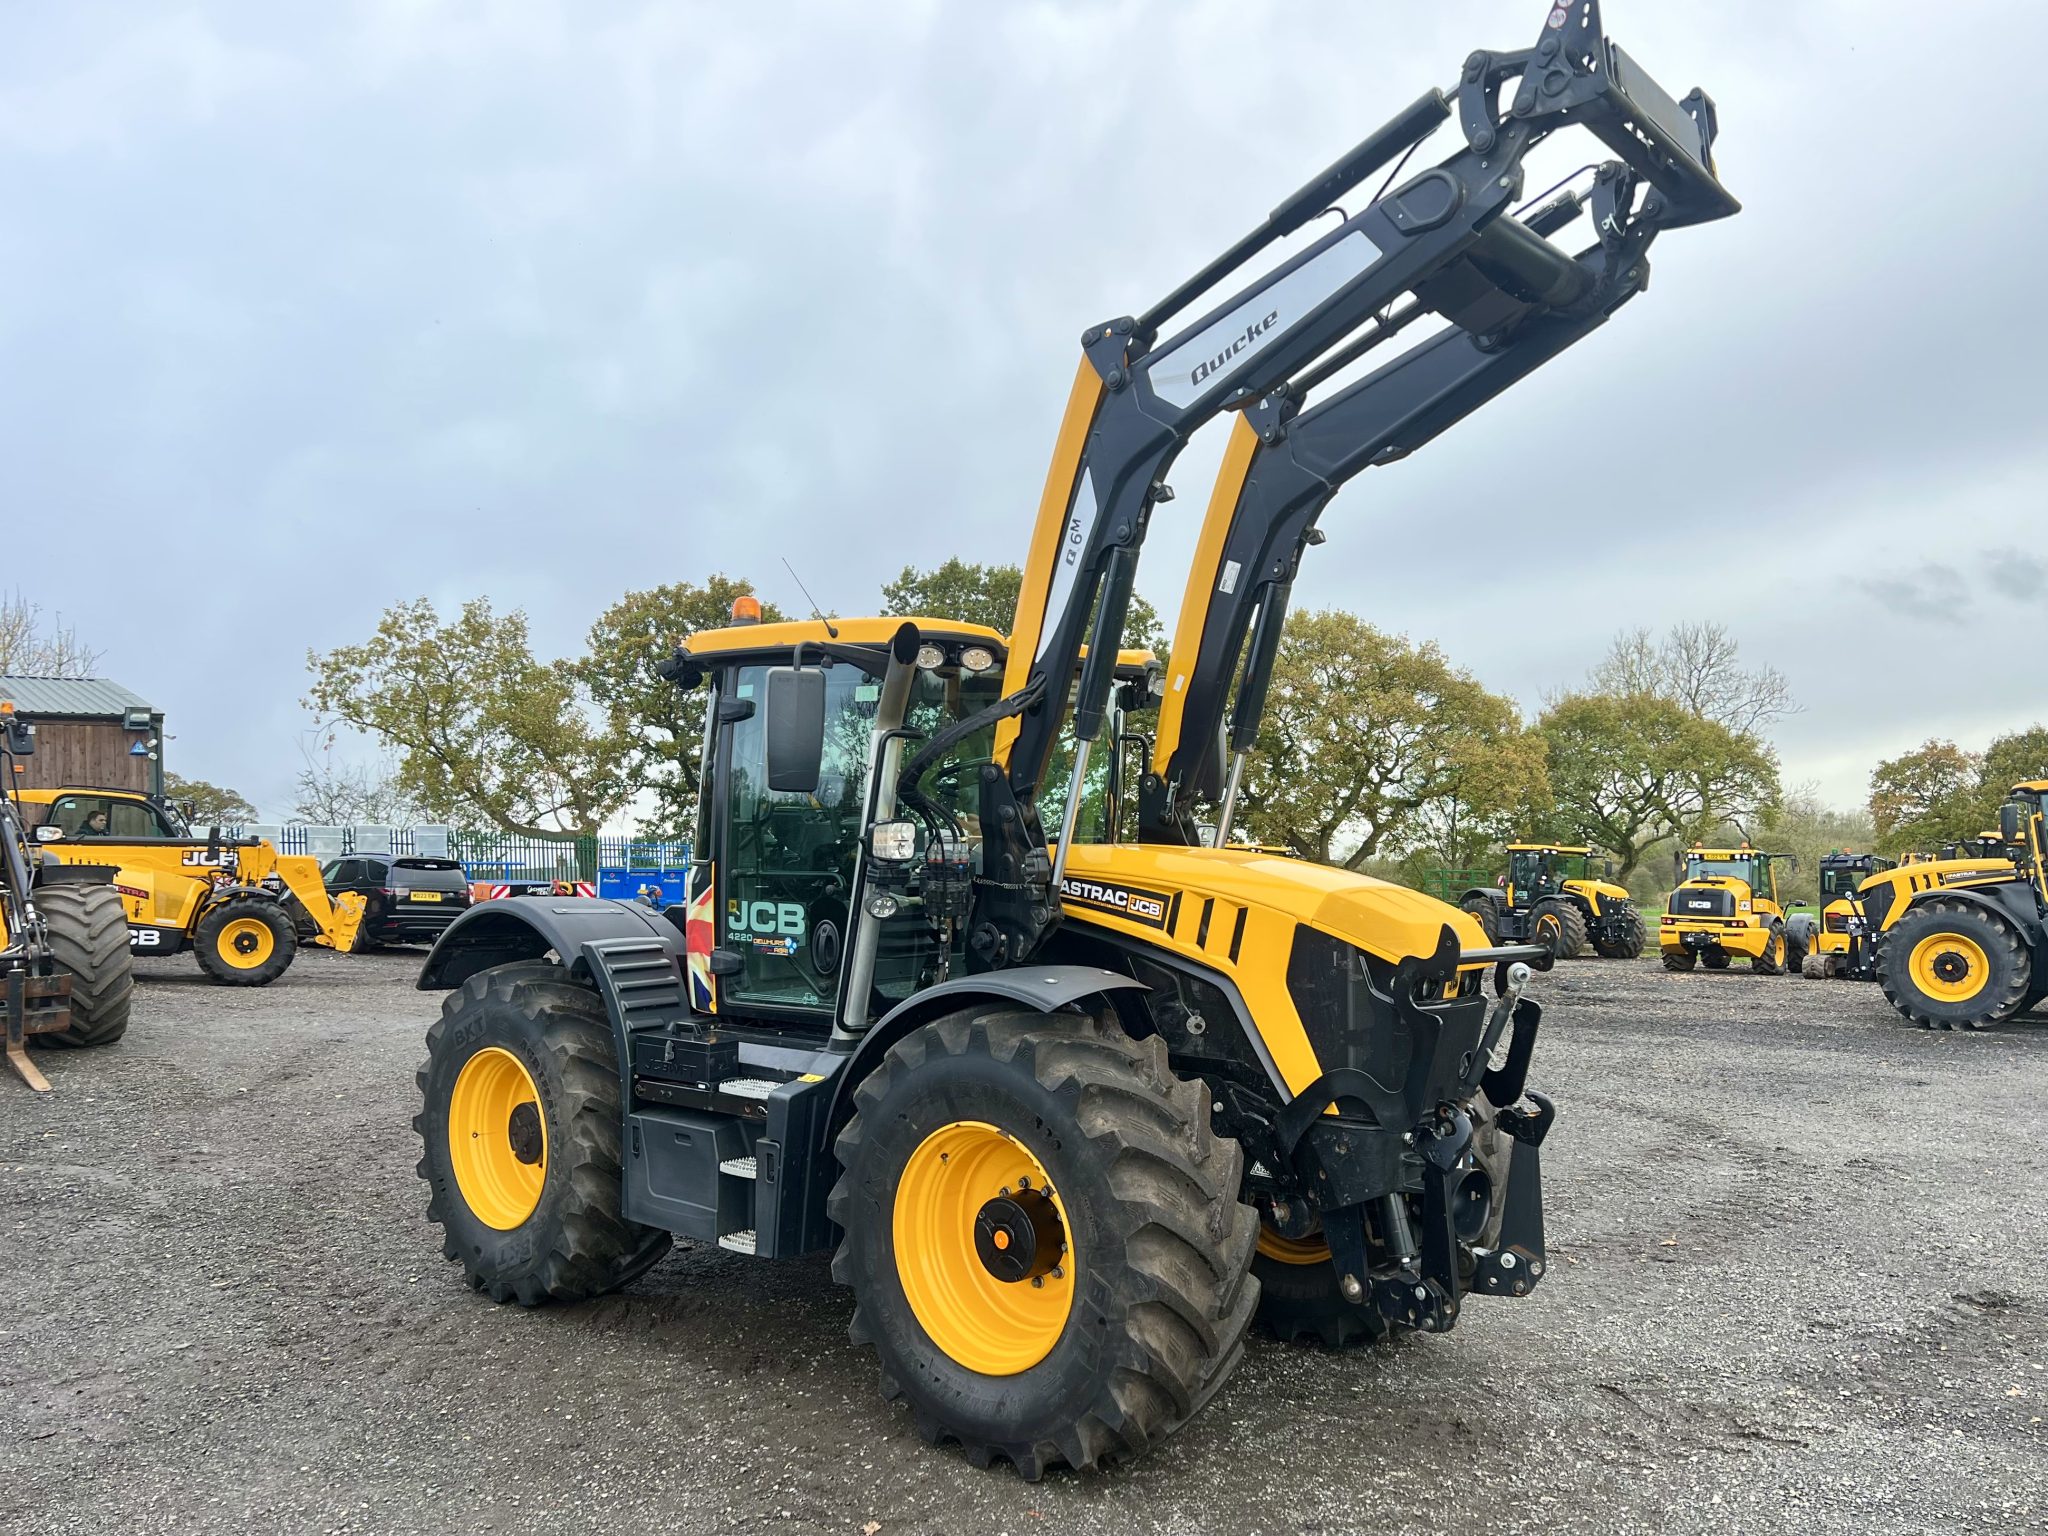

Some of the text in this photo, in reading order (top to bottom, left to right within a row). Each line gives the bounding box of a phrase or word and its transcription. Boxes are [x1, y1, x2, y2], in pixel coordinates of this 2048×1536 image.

[1191, 310, 1278, 386] Quicke
[1060, 880, 1128, 906] ASTRAC
[1130, 899, 1161, 916] JCB
[1688, 900, 1711, 909] JCB
[728, 900, 806, 935] JCB
[128, 929, 161, 946] CB
[727, 932, 753, 942] 4220
[455, 1016, 483, 1046] BKT
